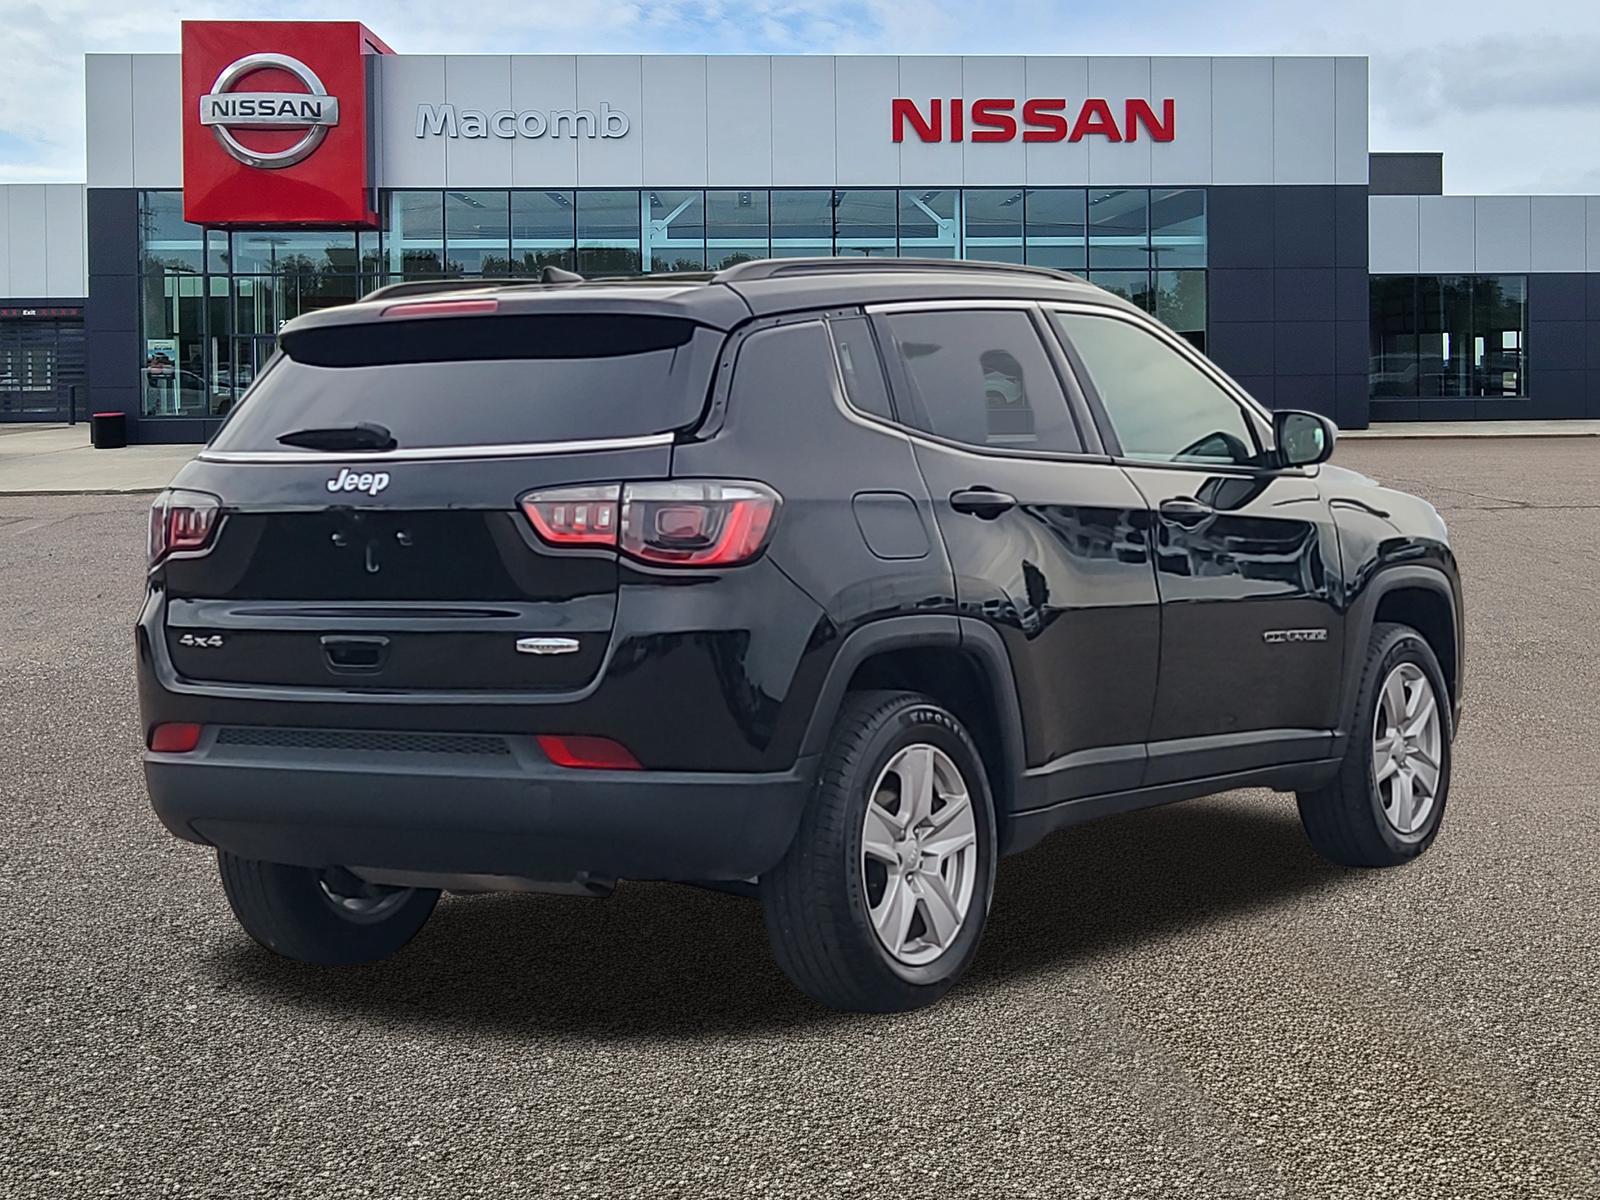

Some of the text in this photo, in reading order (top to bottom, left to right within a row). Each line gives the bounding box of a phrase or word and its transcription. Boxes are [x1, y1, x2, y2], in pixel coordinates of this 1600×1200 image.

[211, 100, 322, 117] NISSAN
[415, 102, 630, 138] Macomb
[891, 98, 1176, 143] NISSAN
[326, 467, 391, 496] Jeep
[179, 634, 224, 647] 4x4
